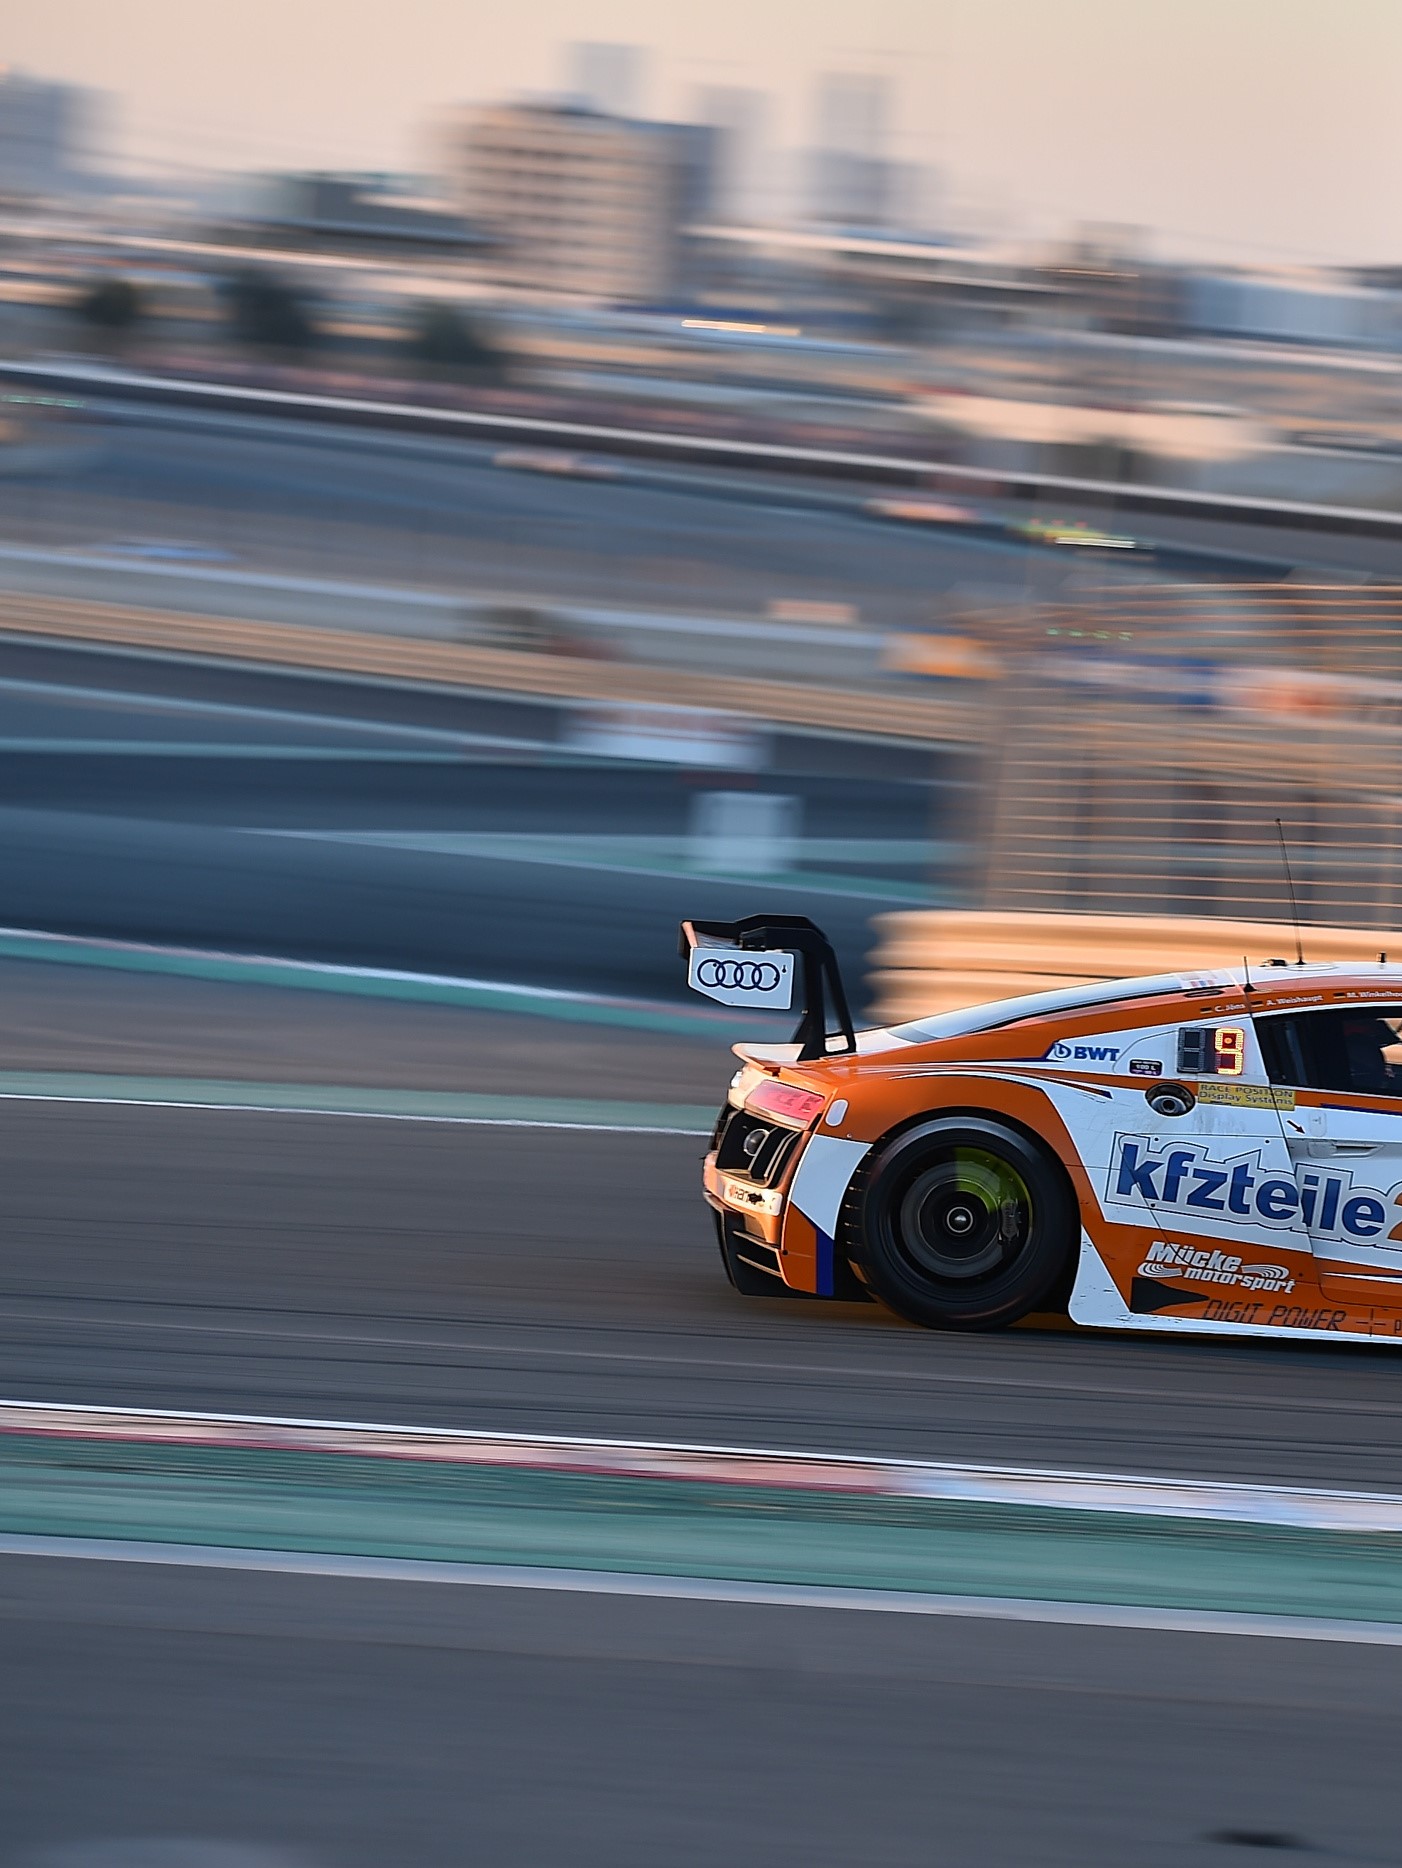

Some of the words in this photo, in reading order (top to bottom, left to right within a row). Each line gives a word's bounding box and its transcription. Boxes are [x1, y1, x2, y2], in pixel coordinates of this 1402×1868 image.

[1073, 1045, 1120, 1062] BWT
[1215, 1027, 1246, 1076] 9
[1199, 1091, 1241, 1103] Display
[1245, 1093, 1294, 1107] Systems
[1200, 1083, 1231, 1094] RACE
[1234, 1086, 1294, 1099] POSITION
[1145, 1240, 1243, 1272] Mücke
[1183, 1266, 1297, 1294] motorsport
[1202, 1299, 1265, 1323] DIGIT
[1268, 1304, 1347, 1330] POWER
